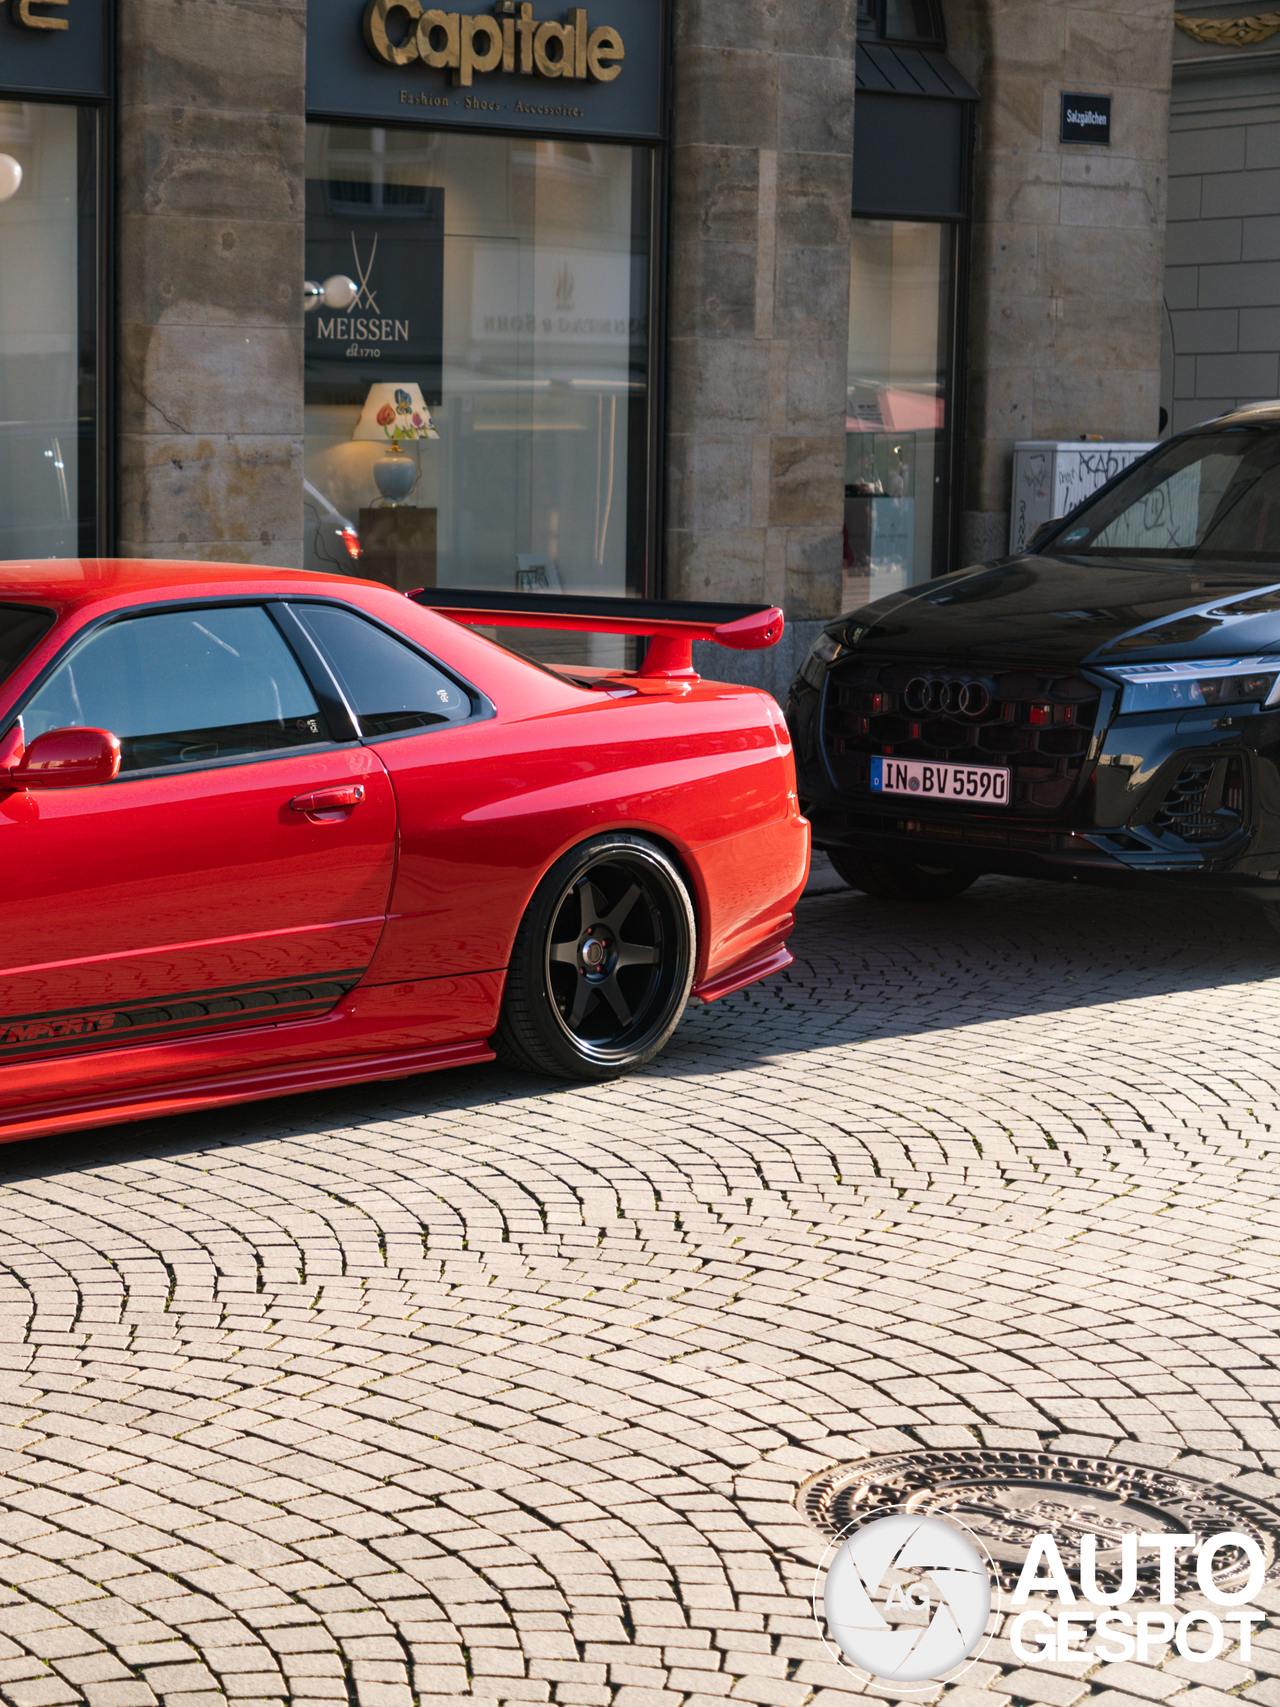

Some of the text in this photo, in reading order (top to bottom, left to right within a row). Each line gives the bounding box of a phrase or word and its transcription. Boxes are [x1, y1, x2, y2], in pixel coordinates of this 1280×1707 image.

[364, 0, 624, 86] Capitale
[400, 90, 584, 117] Fashion Shoes Accessoires
[1066, 109, 1107, 127] Salzgäßchen
[317, 316, 409, 341] MEISSEN
[885, 763, 1005, 798] IN BV 5590
